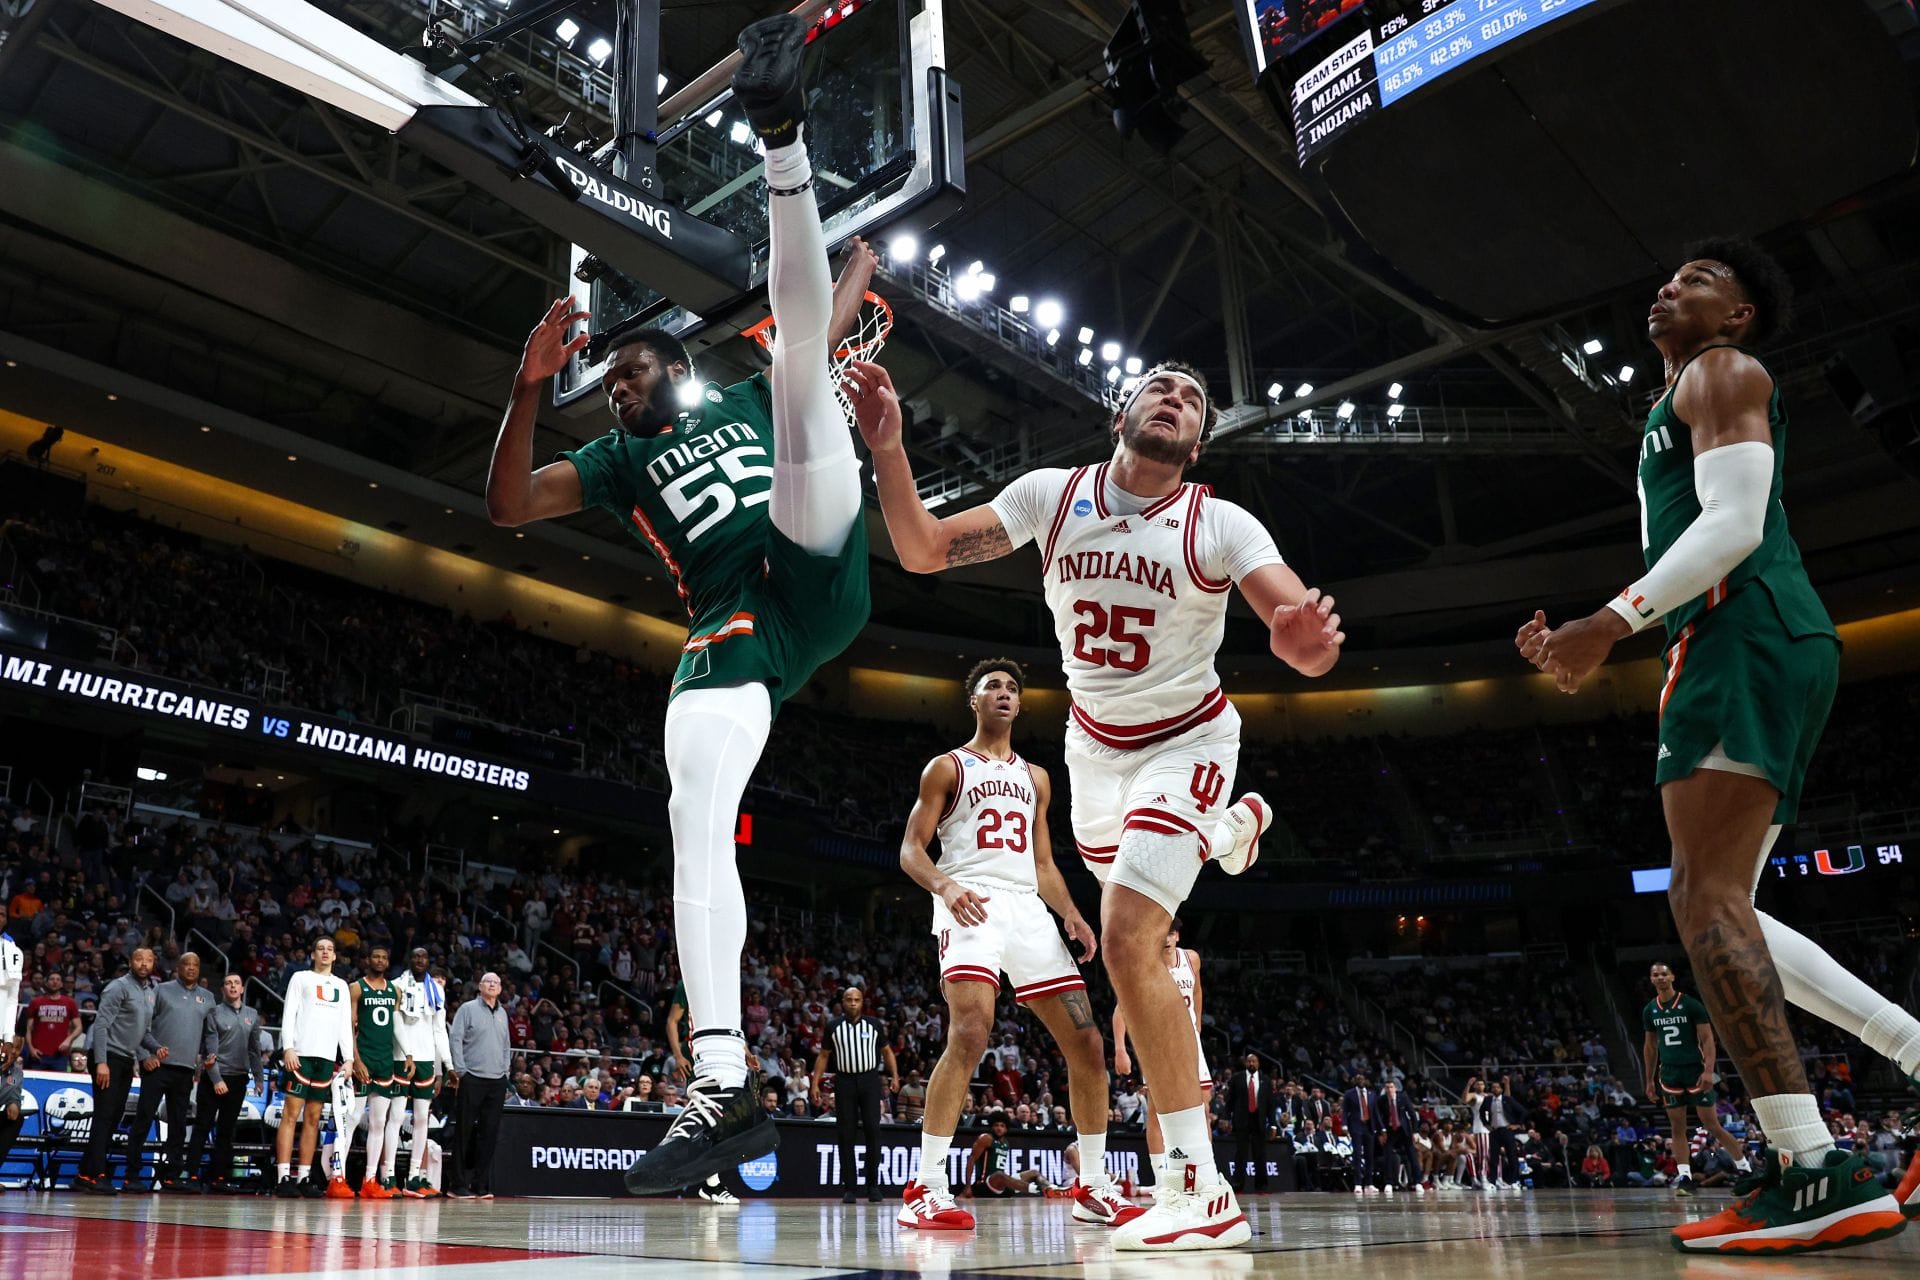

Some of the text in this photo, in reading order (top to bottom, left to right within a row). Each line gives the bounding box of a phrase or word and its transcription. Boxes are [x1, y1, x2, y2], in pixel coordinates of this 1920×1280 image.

[1381, 14, 1407, 39] FG%
[1300, 40, 1368, 94] TEAM STATS
[1309, 7, 1527, 144] INDIANA 46.5% 42.9% 60.0%
[1311, 8, 1466, 114] MIAMI 47.8% 33.3%
[555, 156, 672, 239] SPALDING
[659, 446, 774, 543] 55
[1058, 551, 1177, 600] INDIANA
[1073, 599, 1156, 672] 25
[0, 655, 531, 791] MI HURRICANES VS INDIANA HOOSIERS
[976, 808, 1027, 854] 23
[1876, 844, 1903, 865] 54
[372, 1006, 390, 1027] 0
[1663, 1025, 1682, 1047] 2
[743, 1162, 777, 1177] NCAA
